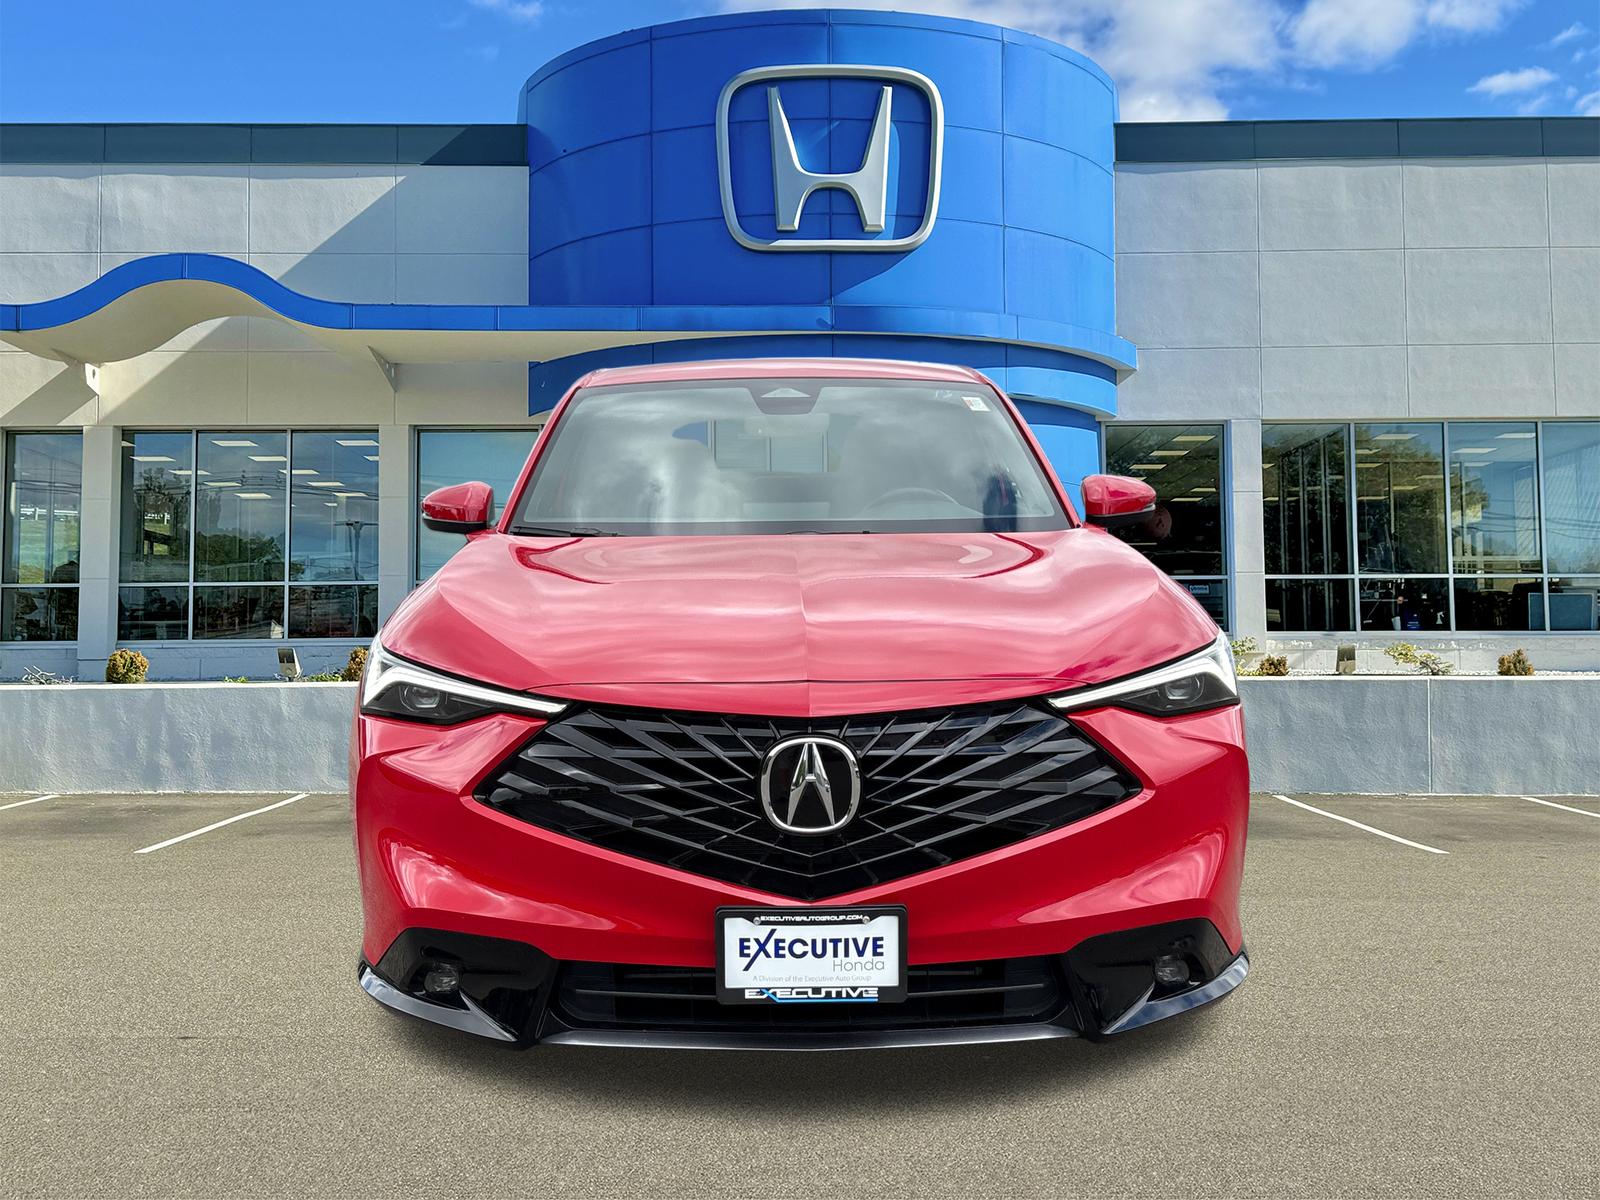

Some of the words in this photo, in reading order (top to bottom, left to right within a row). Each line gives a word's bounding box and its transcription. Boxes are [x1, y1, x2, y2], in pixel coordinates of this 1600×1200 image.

[760, 914, 863, 922] EXECUTIVEAUTOGROUP.COM
[738, 928, 885, 972] EXECUTIVE
[832, 958, 885, 973] Honda
[760, 975, 783, 983] Division
[785, 975, 792, 983] of
[792, 975, 803, 983] the
[804, 975, 834, 983] Executive
[851, 974, 872, 983] Group
[744, 987, 879, 1002] EXECUTIVE
